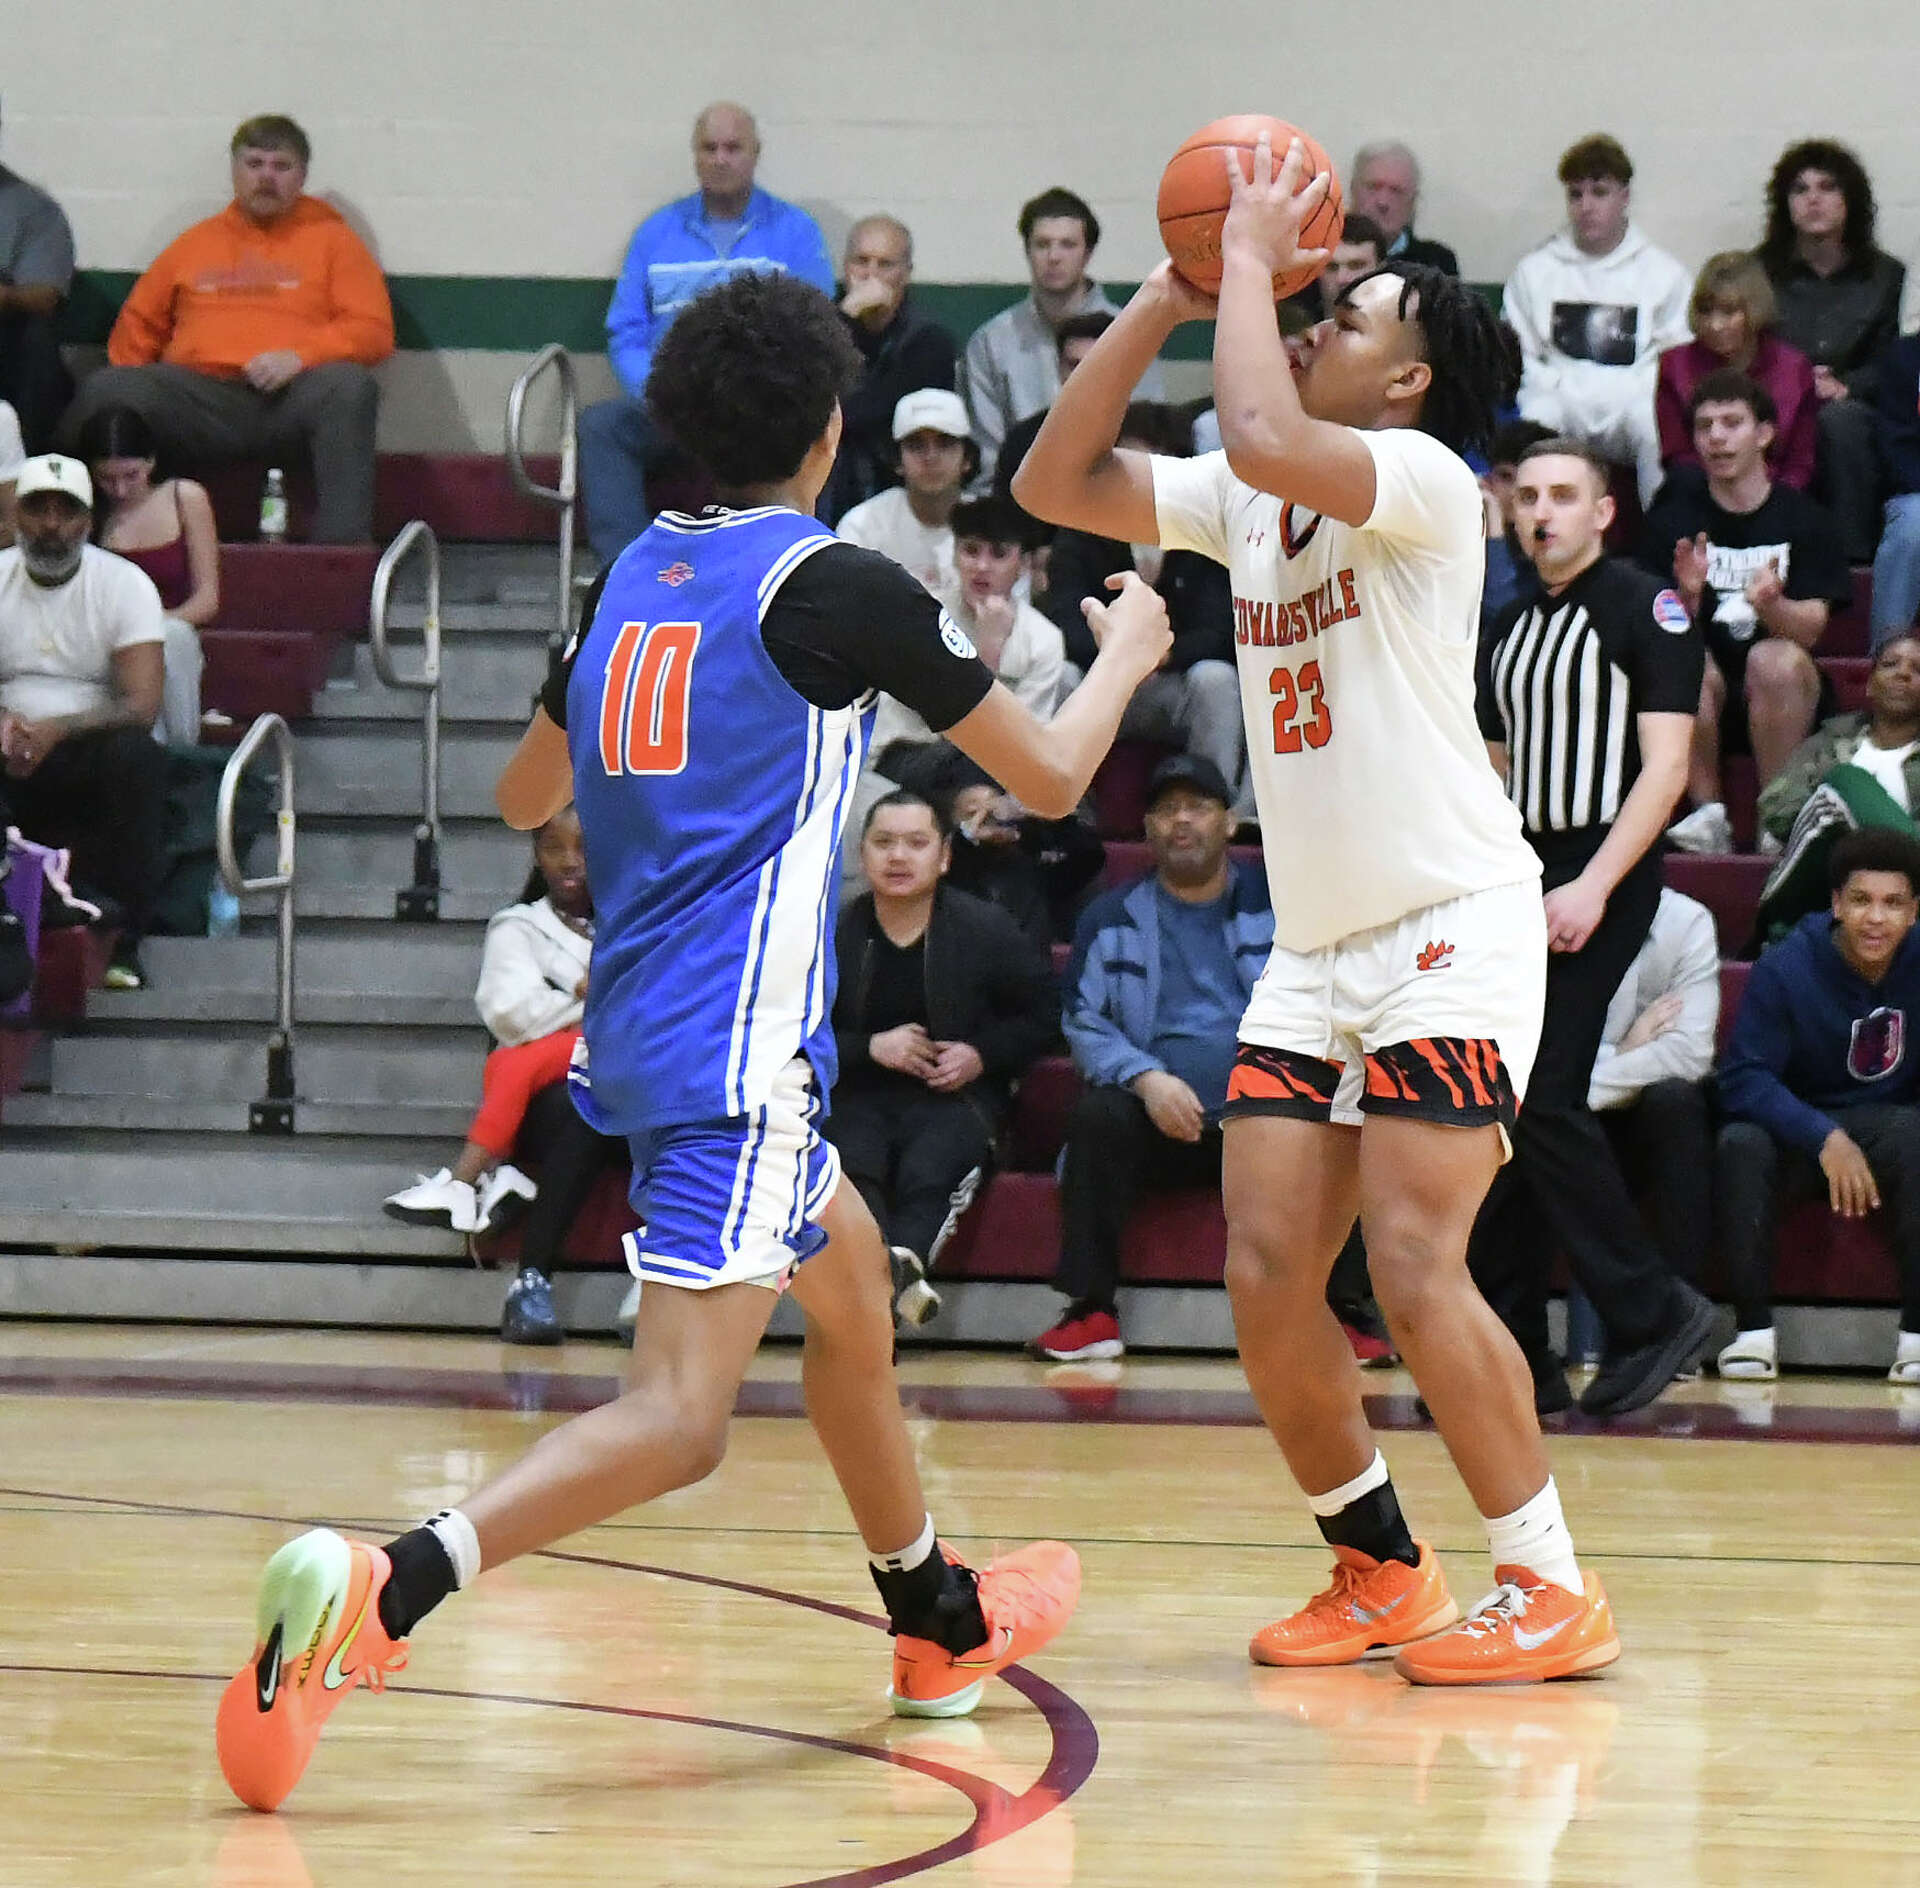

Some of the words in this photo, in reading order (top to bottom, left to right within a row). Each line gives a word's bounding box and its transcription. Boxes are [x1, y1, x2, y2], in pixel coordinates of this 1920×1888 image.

[1233, 568, 1361, 647] DWARSVLLE
[599, 621, 702, 776] 10
[1269, 659, 1332, 754] 23
